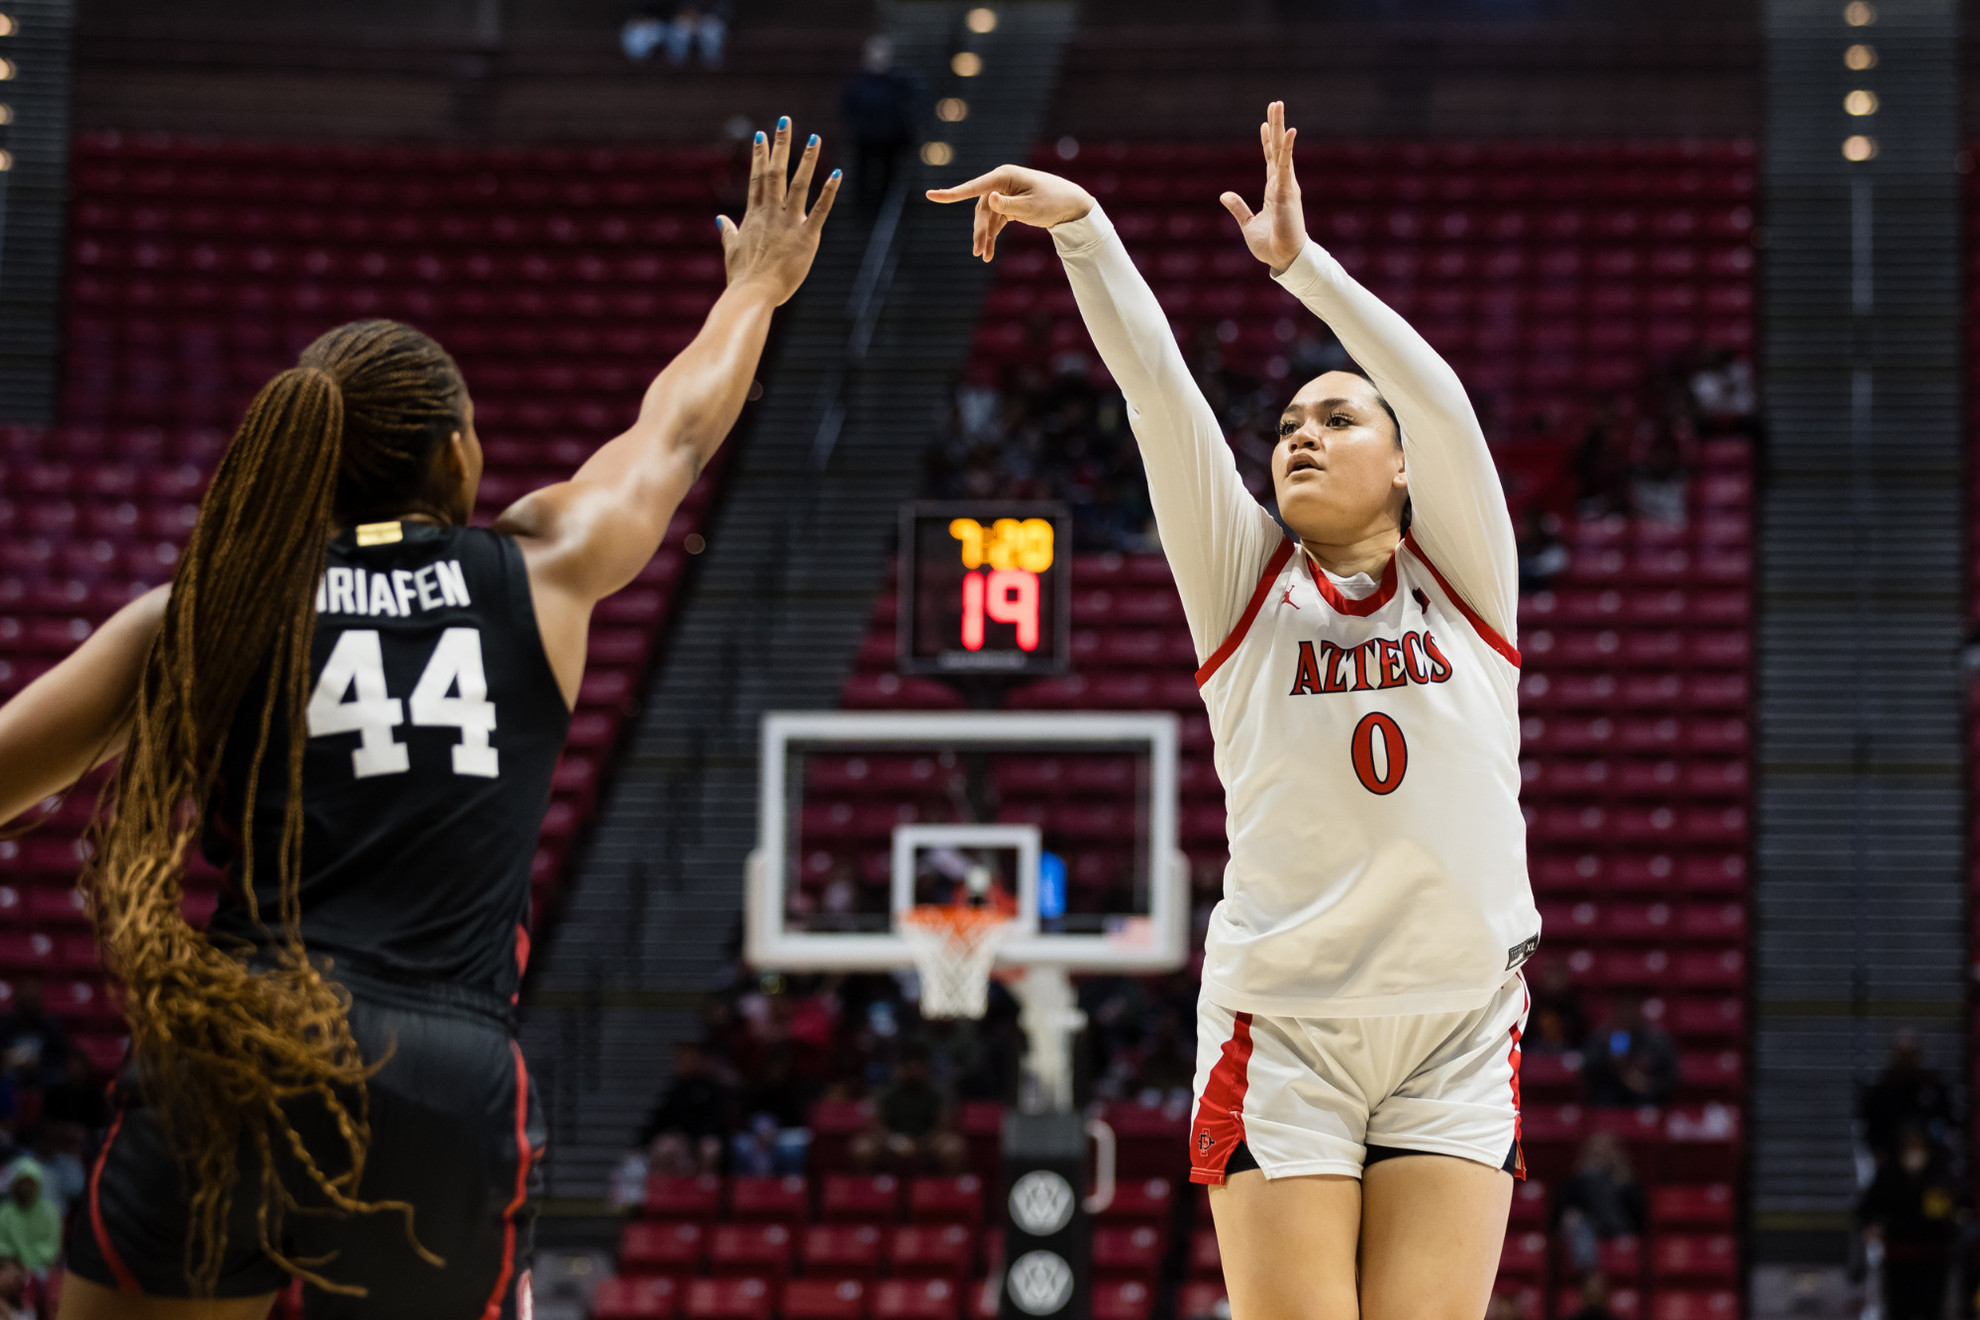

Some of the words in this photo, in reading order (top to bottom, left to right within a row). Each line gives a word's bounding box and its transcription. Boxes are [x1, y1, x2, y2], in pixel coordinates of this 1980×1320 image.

[961, 569, 1040, 652] 19
[305, 627, 500, 780] 44
[1288, 630, 1453, 696] AZTECS
[1350, 711, 1409, 796] 0
[1525, 941, 1536, 953] XL
